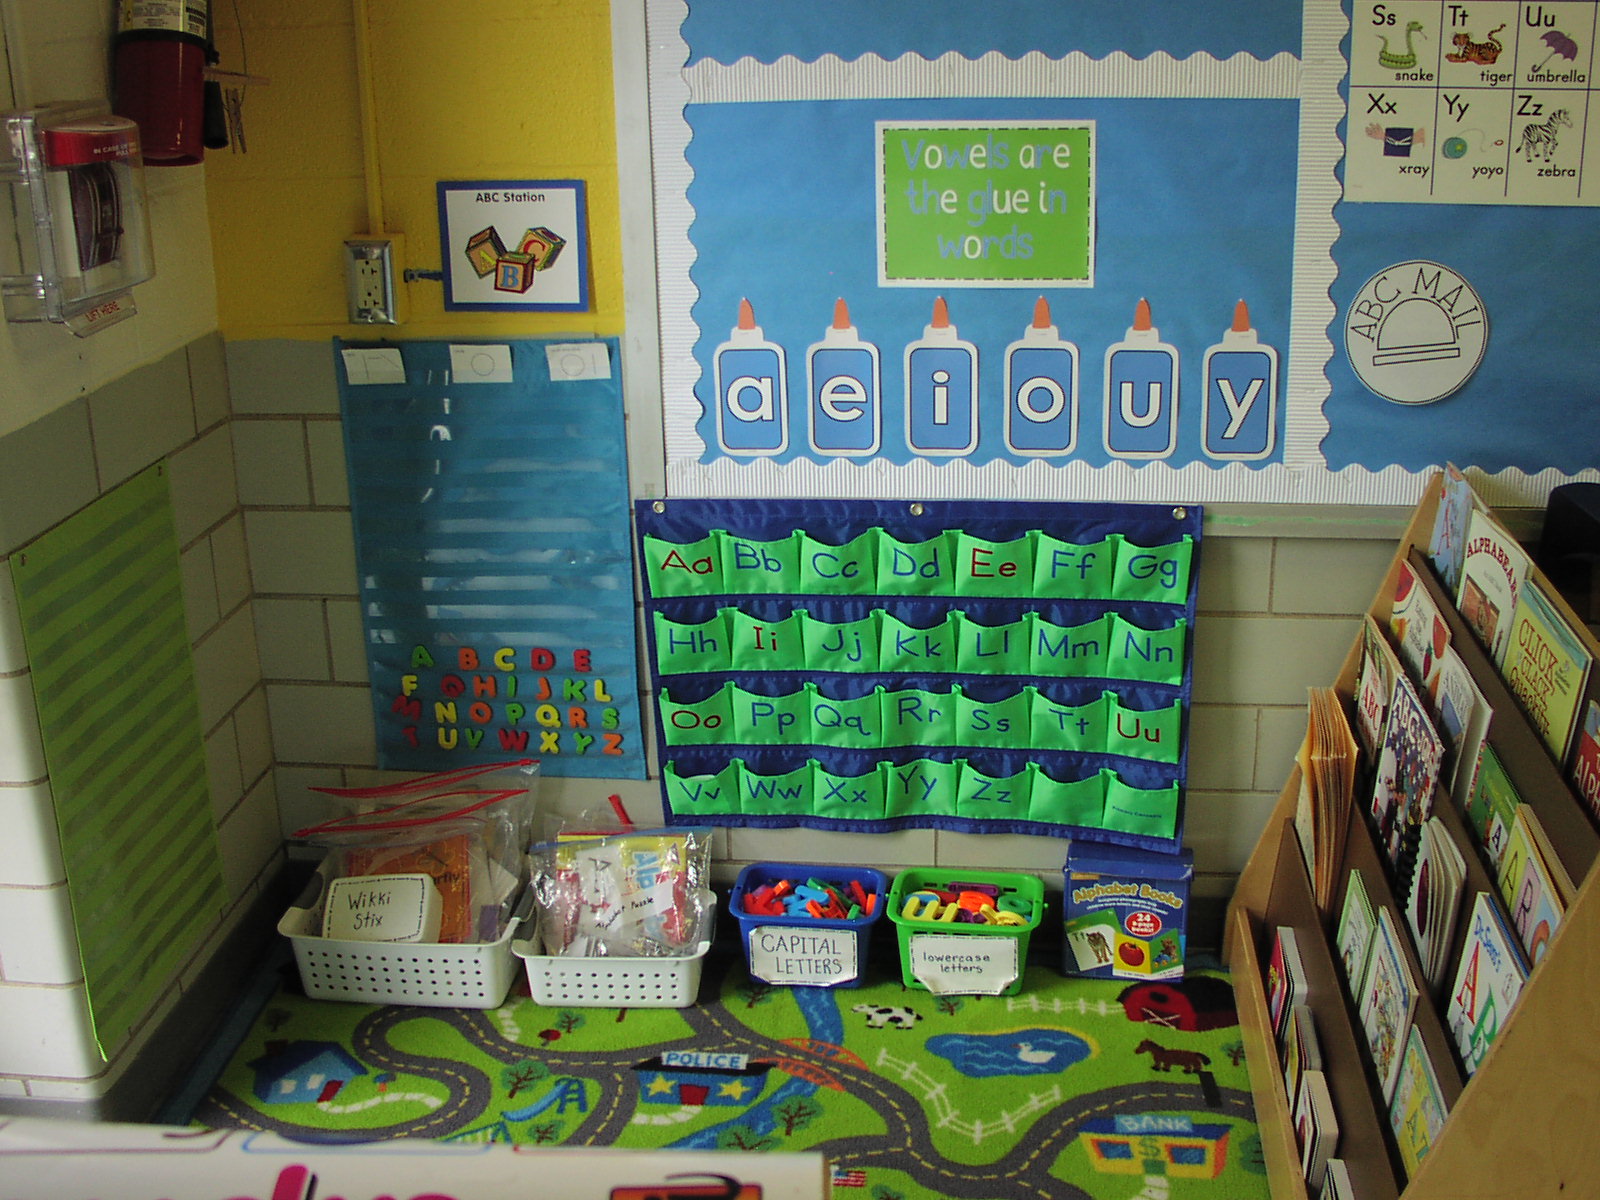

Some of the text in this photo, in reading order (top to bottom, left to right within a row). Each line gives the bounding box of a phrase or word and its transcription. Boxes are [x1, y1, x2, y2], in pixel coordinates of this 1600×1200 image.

[1372, 4, 1396, 25] Ss
[1448, 6, 1469, 26] Tt
[1526, 6, 1555, 27] Uu
[1395, 69, 1434, 82] snake
[1480, 70, 1513, 86] tiger
[1527, 70, 1586, 83] umbrella
[1367, 93, 1397, 115] Xx
[1443, 94, 1469, 122] Yy
[1517, 95, 1543, 116] Zz
[901, 134, 1071, 171] Vowels are
[1399, 165, 1430, 177] xray
[1472, 166, 1504, 179] yoyo
[1537, 165, 1576, 178] zebra
[475, 192, 545, 203] ABC Station
[905, 178, 1067, 227] the glue in
[937, 225, 1034, 260] words
[1350, 267, 1481, 343] ABC MAIL
[726, 370, 1265, 440] a e i o u y
[661, 542, 1178, 589] Aa Bb Cc Dd Ee Ff Gg
[670, 628, 717, 654] Hh
[753, 626, 777, 651] Ii
[822, 629, 862, 662] Jj
[895, 629, 941, 657] Kk
[1038, 628, 1099, 659] Mm
[1125, 631, 1173, 662] Nn
[411, 645, 592, 672] A B C D E
[401, 674, 418, 697] F
[472, 674, 497, 698] H
[535, 677, 552, 701] J
[563, 678, 587, 702] K
[593, 679, 612, 702] L
[391, 695, 620, 730] M N O P Q R S
[671, 696, 1160, 743] Oo Pp Qq Rr Ss Tt Uu
[437, 727, 459, 750] U
[465, 728, 484, 750] V
[498, 728, 529, 751] W
[539, 730, 560, 754] X
[573, 732, 594, 755] Y
[602, 732, 624, 755] Z
[679, 765, 1012, 803] Vv Ww Xx Yy Zz
[347, 891, 391, 910] Wikki
[353, 910, 384, 931] Stix
[761, 933, 842, 955] CAPITAL
[776, 956, 843, 976] LETTERS
[923, 952, 990, 963] lowercase
[940, 963, 983, 974] letters
[665, 1051, 742, 1069] POLICE
[1120, 1115, 1192, 1133] BANK
